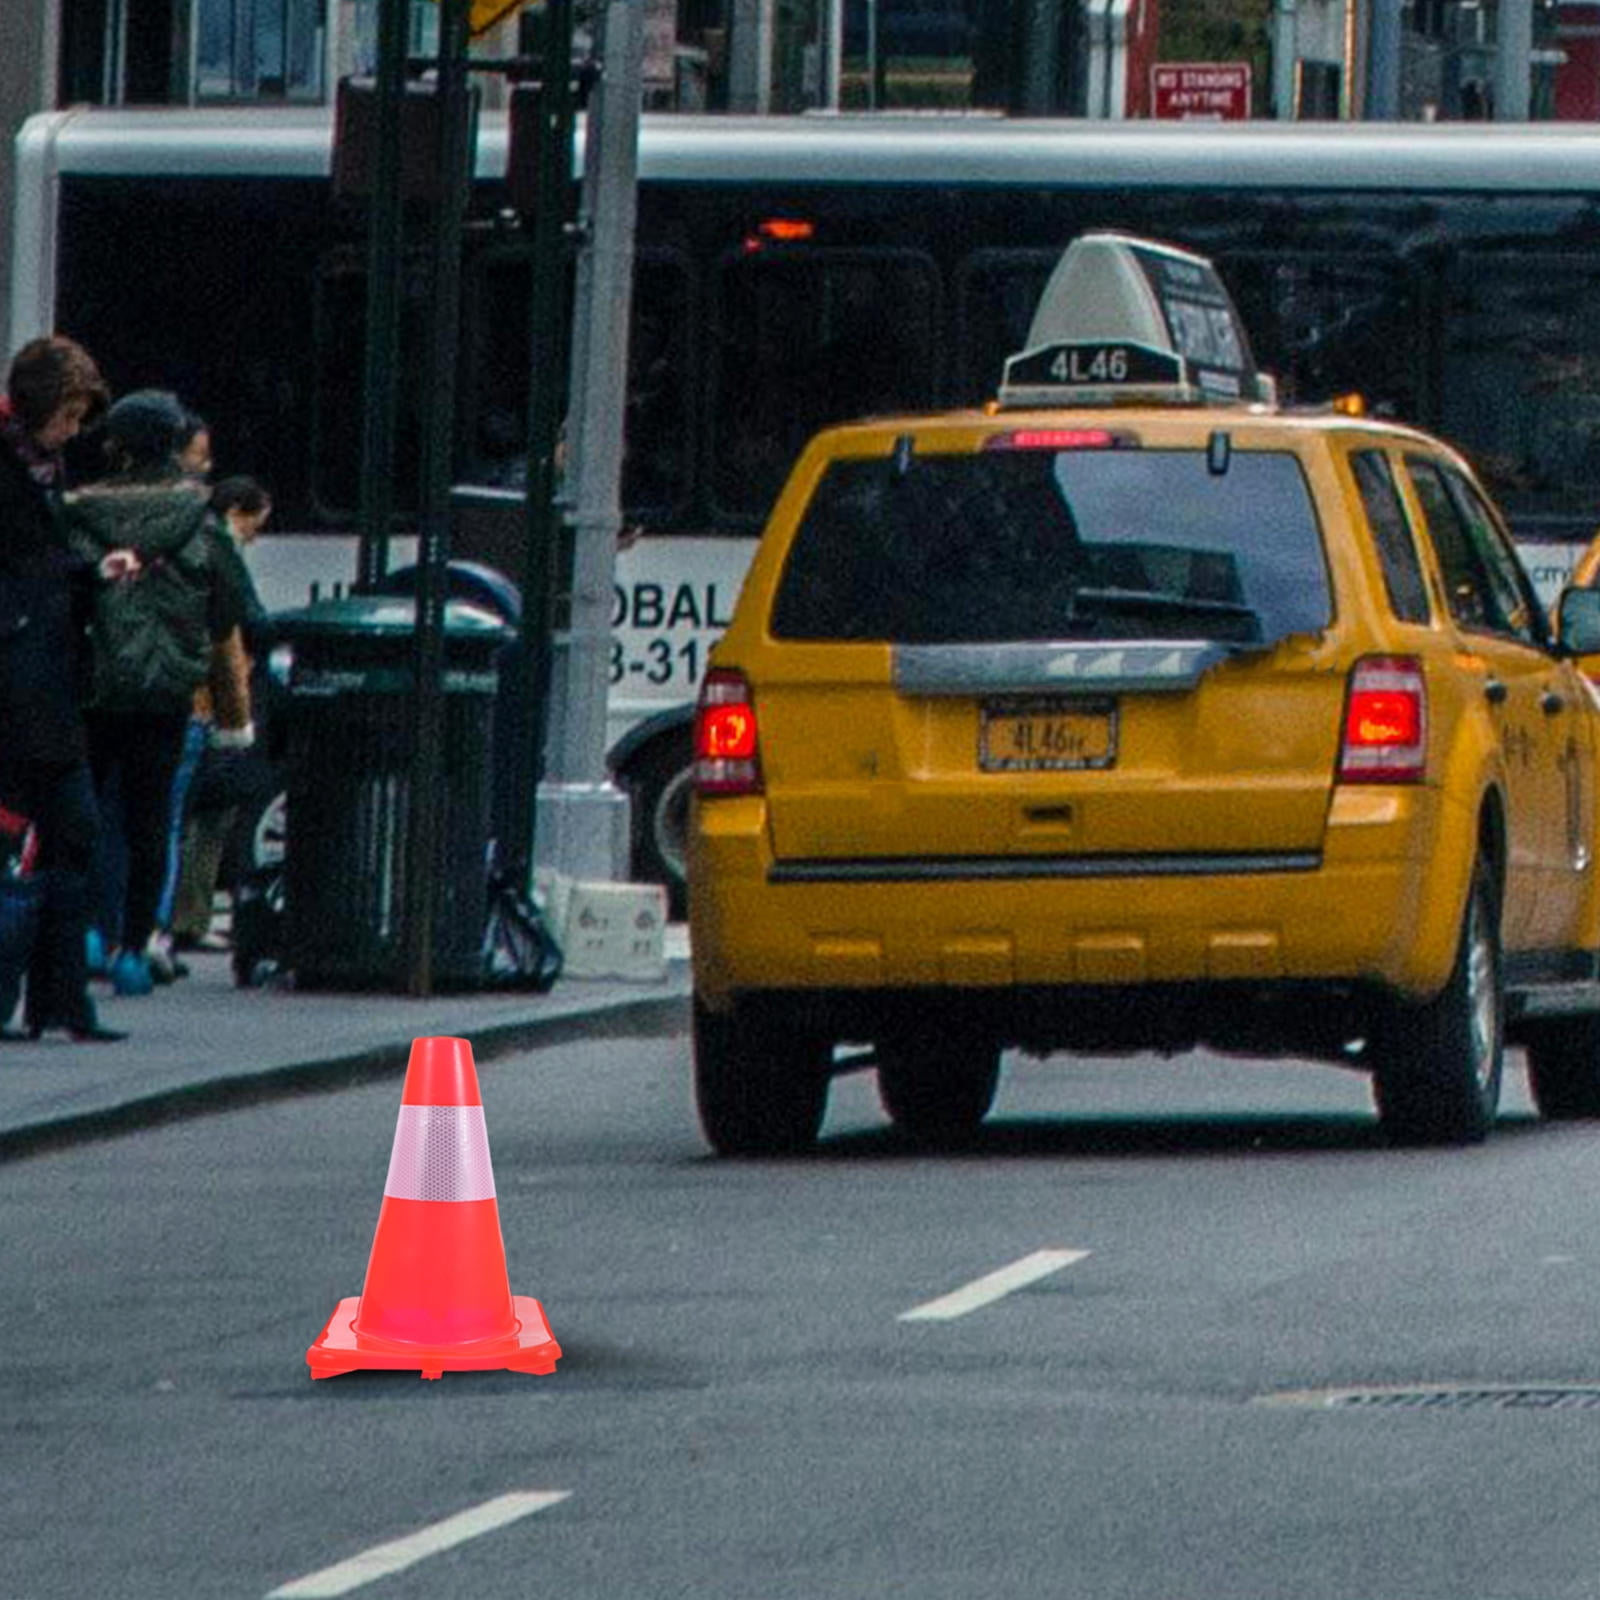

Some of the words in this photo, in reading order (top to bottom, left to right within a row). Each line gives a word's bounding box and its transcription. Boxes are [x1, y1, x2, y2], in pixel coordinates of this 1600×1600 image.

[1181, 72, 1242, 89] STANDING
[1169, 90, 1232, 107] ANYTIME
[1051, 350, 1127, 381] 4L46
[610, 639, 719, 684] -31
